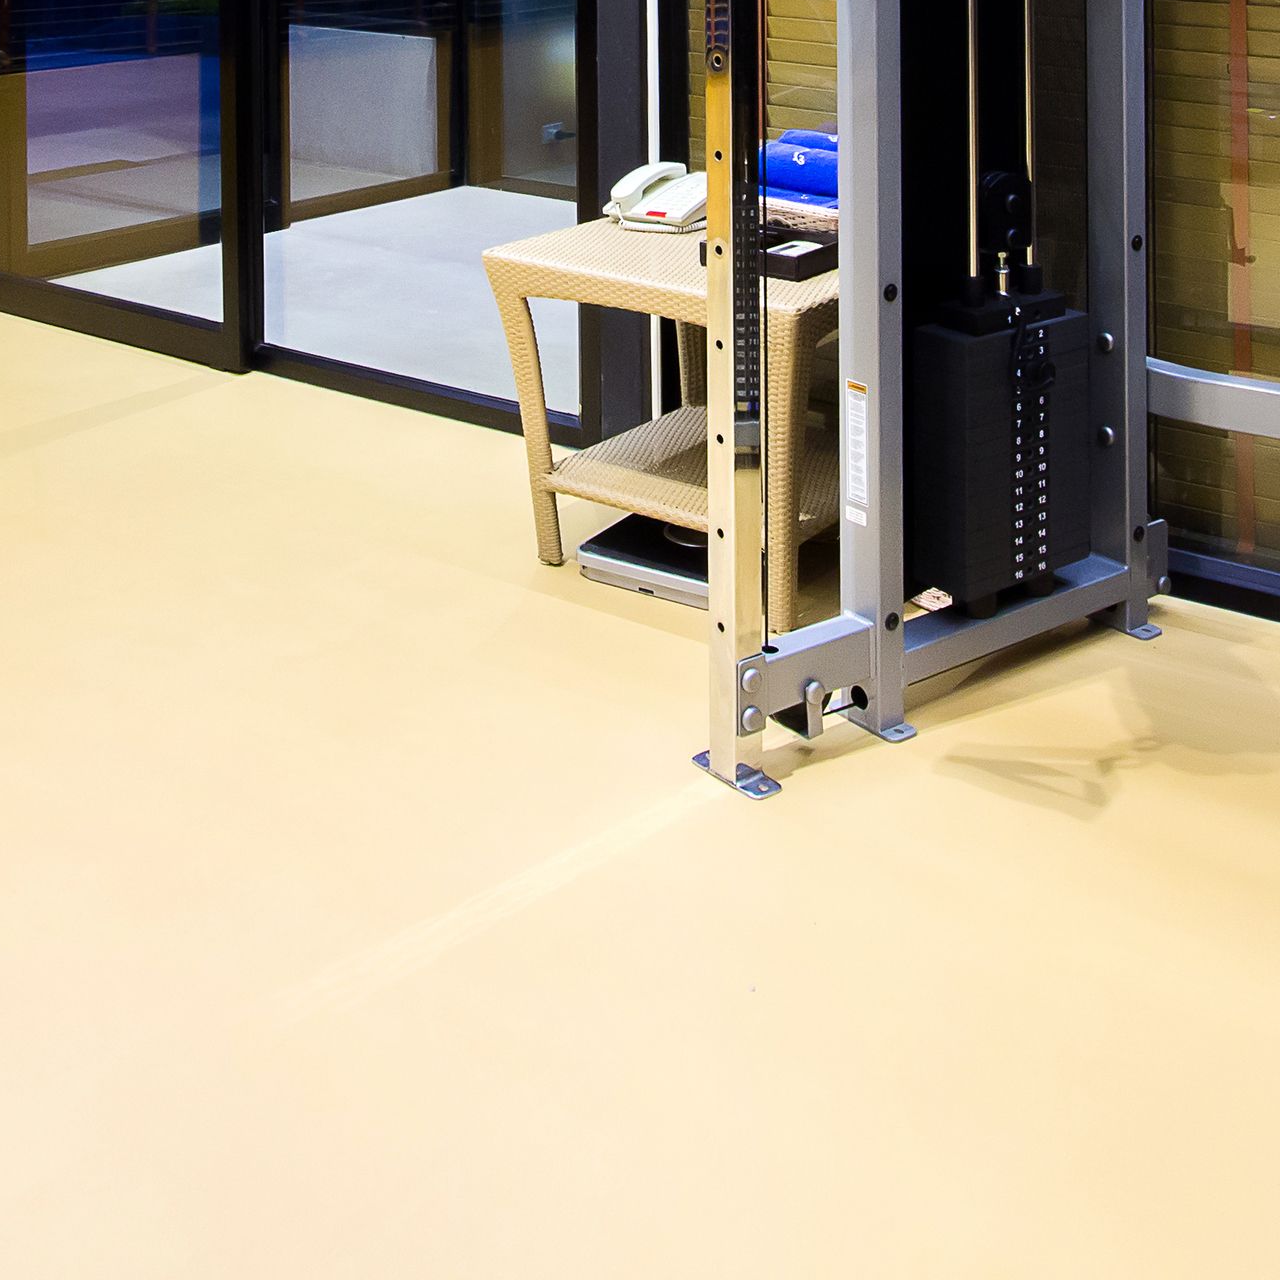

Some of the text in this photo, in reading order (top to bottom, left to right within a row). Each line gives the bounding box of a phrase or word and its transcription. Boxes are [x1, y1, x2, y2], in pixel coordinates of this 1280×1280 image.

[1038, 462, 1047, 472] 10
[1015, 469, 1024, 479] 10
[1038, 479, 1047, 489] 11
[1015, 486, 1024, 496] 11
[1038, 495, 1047, 505] 12
[1015, 502, 1024, 512] 12
[1038, 511, 1047, 521] 13
[1015, 519, 1024, 529] 13
[1038, 528, 1047, 538] 14
[1015, 536, 1024, 546] 14
[1038, 545, 1047, 555] 15
[1015, 553, 1024, 563] 15
[1038, 561, 1047, 571] 16
[1015, 570, 1024, 580] 16
